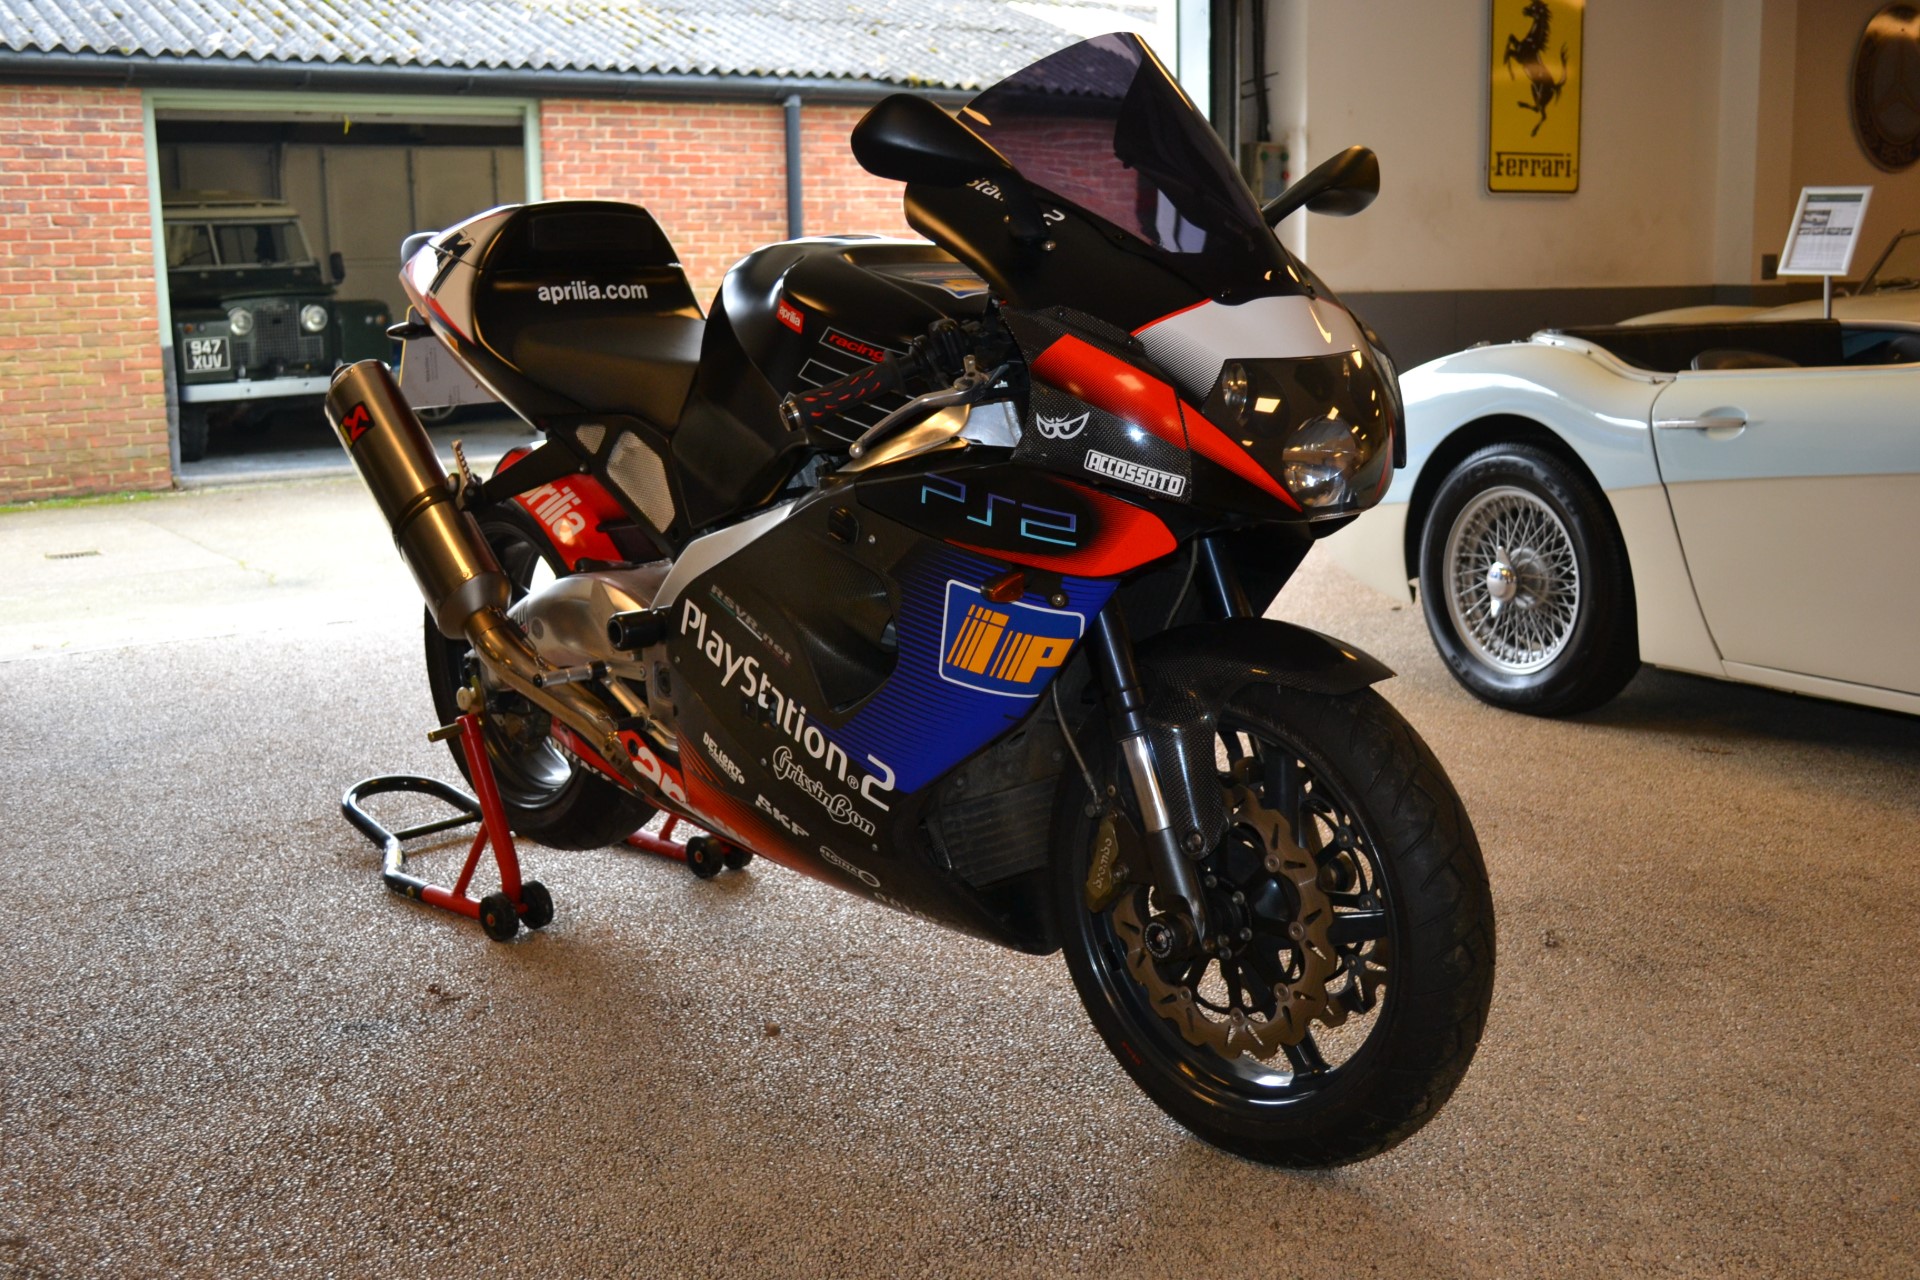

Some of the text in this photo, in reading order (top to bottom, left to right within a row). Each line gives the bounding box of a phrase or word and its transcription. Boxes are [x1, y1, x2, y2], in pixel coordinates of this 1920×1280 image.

[1494, 151, 1571, 178] Ferrari
[538, 281, 648, 304] aprilia.com
[779, 305, 801, 327] aprilia
[190, 339, 222, 355] 947
[829, 333, 884, 362] racing
[192, 354, 222, 370] XUV
[1087, 453, 1182, 494] ACCOSSATO
[519, 482, 586, 542] rilia
[921, 472, 1077, 546] PS2
[755, 794, 810, 837] SKF
